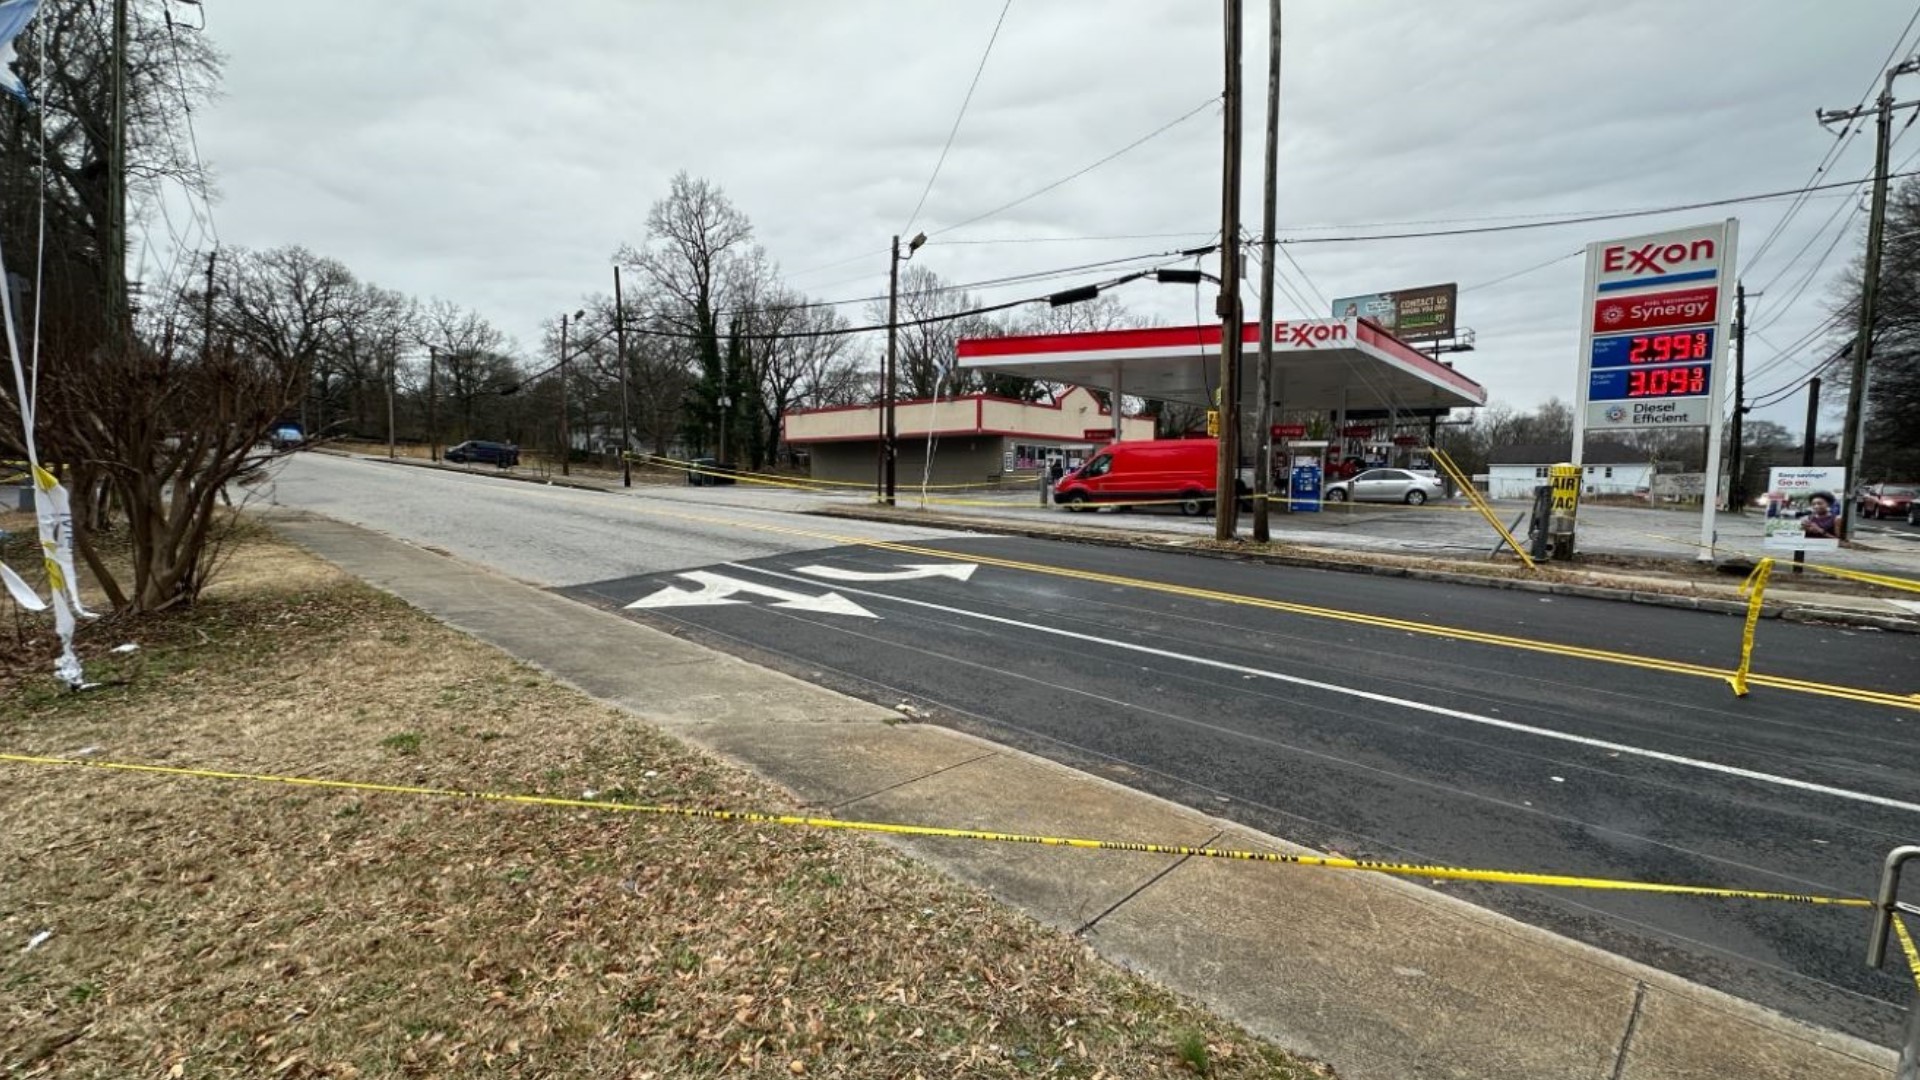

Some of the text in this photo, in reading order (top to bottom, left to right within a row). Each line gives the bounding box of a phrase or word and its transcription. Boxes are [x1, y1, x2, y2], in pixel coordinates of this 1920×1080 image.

[1604, 239, 1714, 274] Exxon
[1400, 296, 1434, 309] CONTACT
[1437, 294, 1448, 304] US
[1630, 301, 1710, 321] Synergy
[1275, 323, 1347, 347] Exxon
[1630, 334, 1691, 363] 2.99
[1628, 368, 1689, 396] 3.09
[1634, 402, 1676, 414] Diesel
[1633, 413, 1688, 424] Efficient
[1553, 478, 1575, 490] AIR
[1778, 478, 1793, 486] Go
